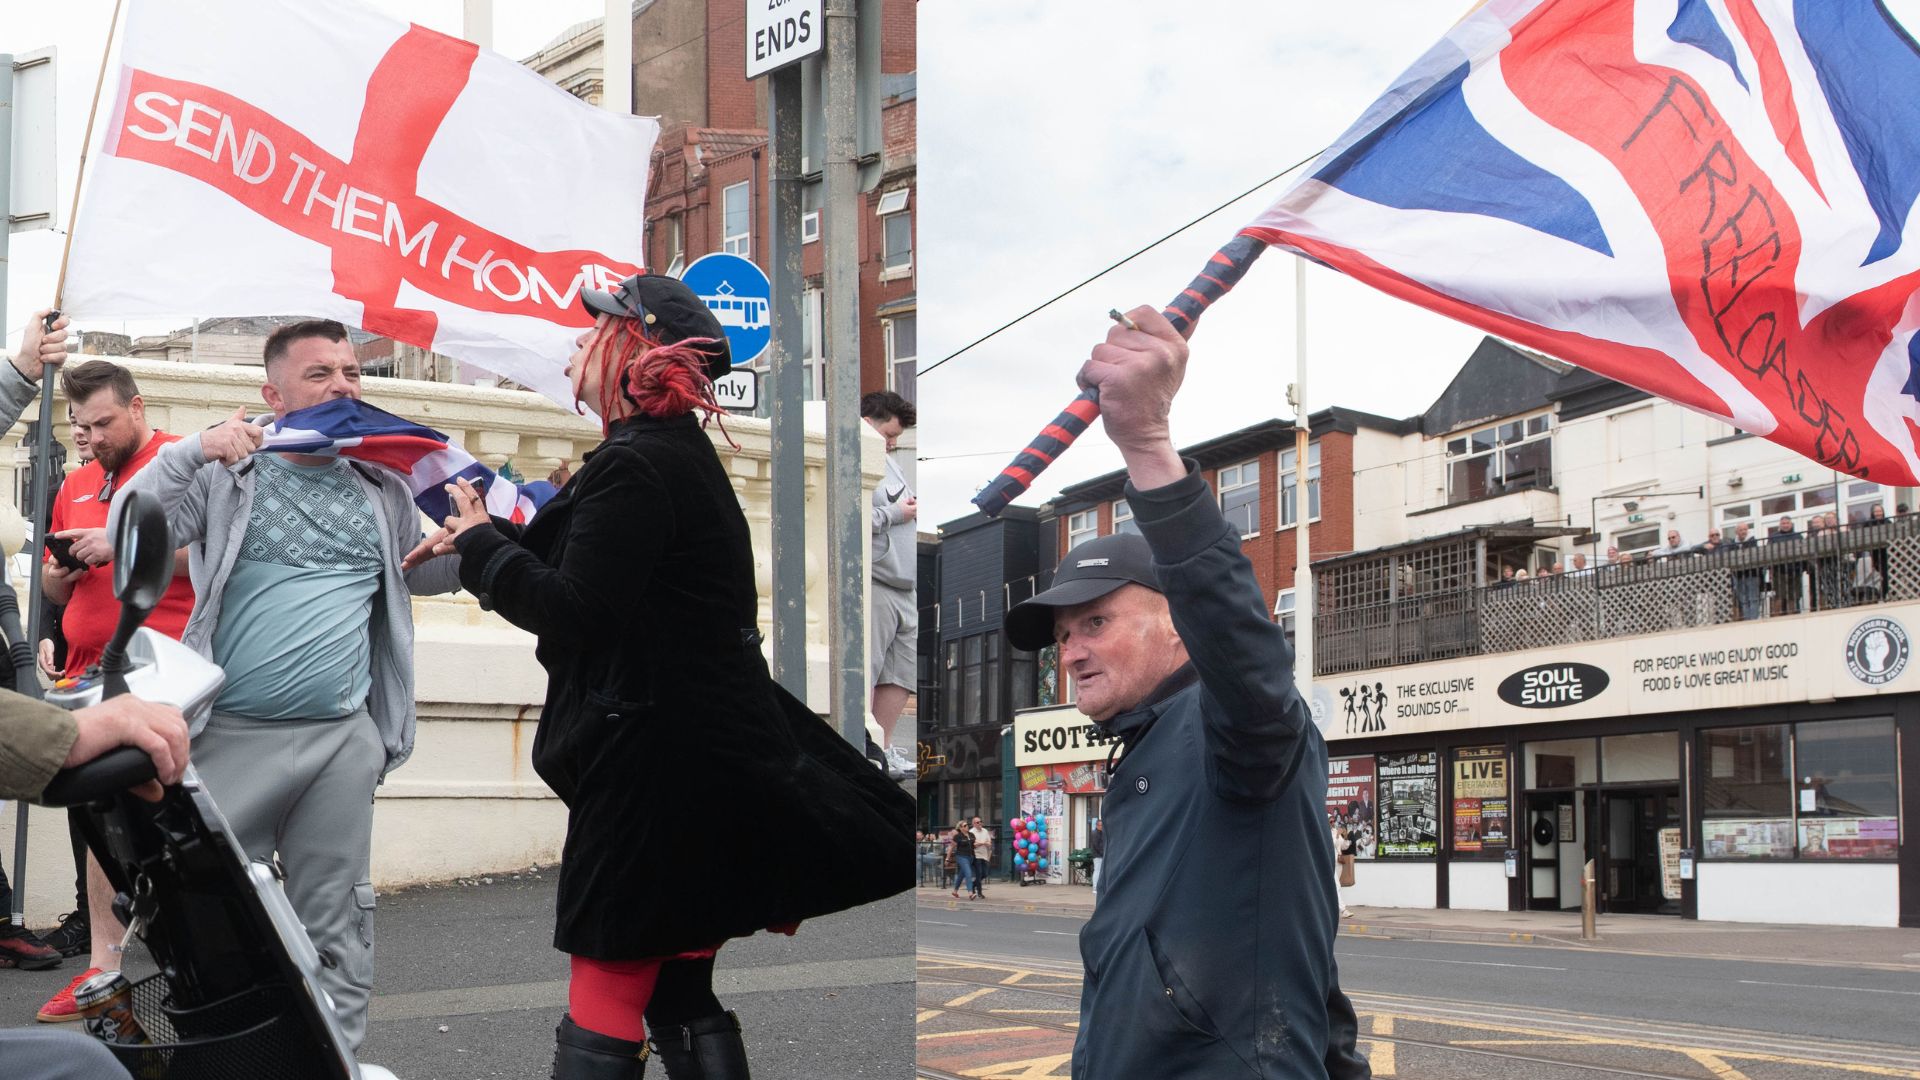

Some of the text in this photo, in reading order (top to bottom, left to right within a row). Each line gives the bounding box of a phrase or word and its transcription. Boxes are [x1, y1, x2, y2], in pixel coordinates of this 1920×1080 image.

[755, 10, 811, 61] ENDS
[127, 91, 276, 185] SEND
[281, 152, 439, 268] THEM
[1621, 75, 1869, 479] FREELOADER
[711, 379, 747, 401] nly
[1848, 620, 1906, 647] NORTHERN SOUL
[1633, 642, 1799, 673] FOR PEOPLE WHO ENJOY GOOD
[1523, 667, 1581, 688] SOUL
[1642, 664, 1789, 692] FOOD & LOVE GREAT MUSIC
[1848, 657, 1906, 684] KEEP THE FAITH
[1396, 677, 1474, 699] THE EXCLUSIVE
[1521, 683, 1583, 705] SUITE
[1397, 701, 1441, 718] SOUNDS
[1328, 760, 1349, 775] IVE
[1380, 766, 1401, 776] Where
[1402, 765, 1407, 774] it
[1408, 764, 1416, 774] all
[1460, 761, 1503, 780] LIVE
[1328, 775, 1372, 785] NTERTAINMENT
